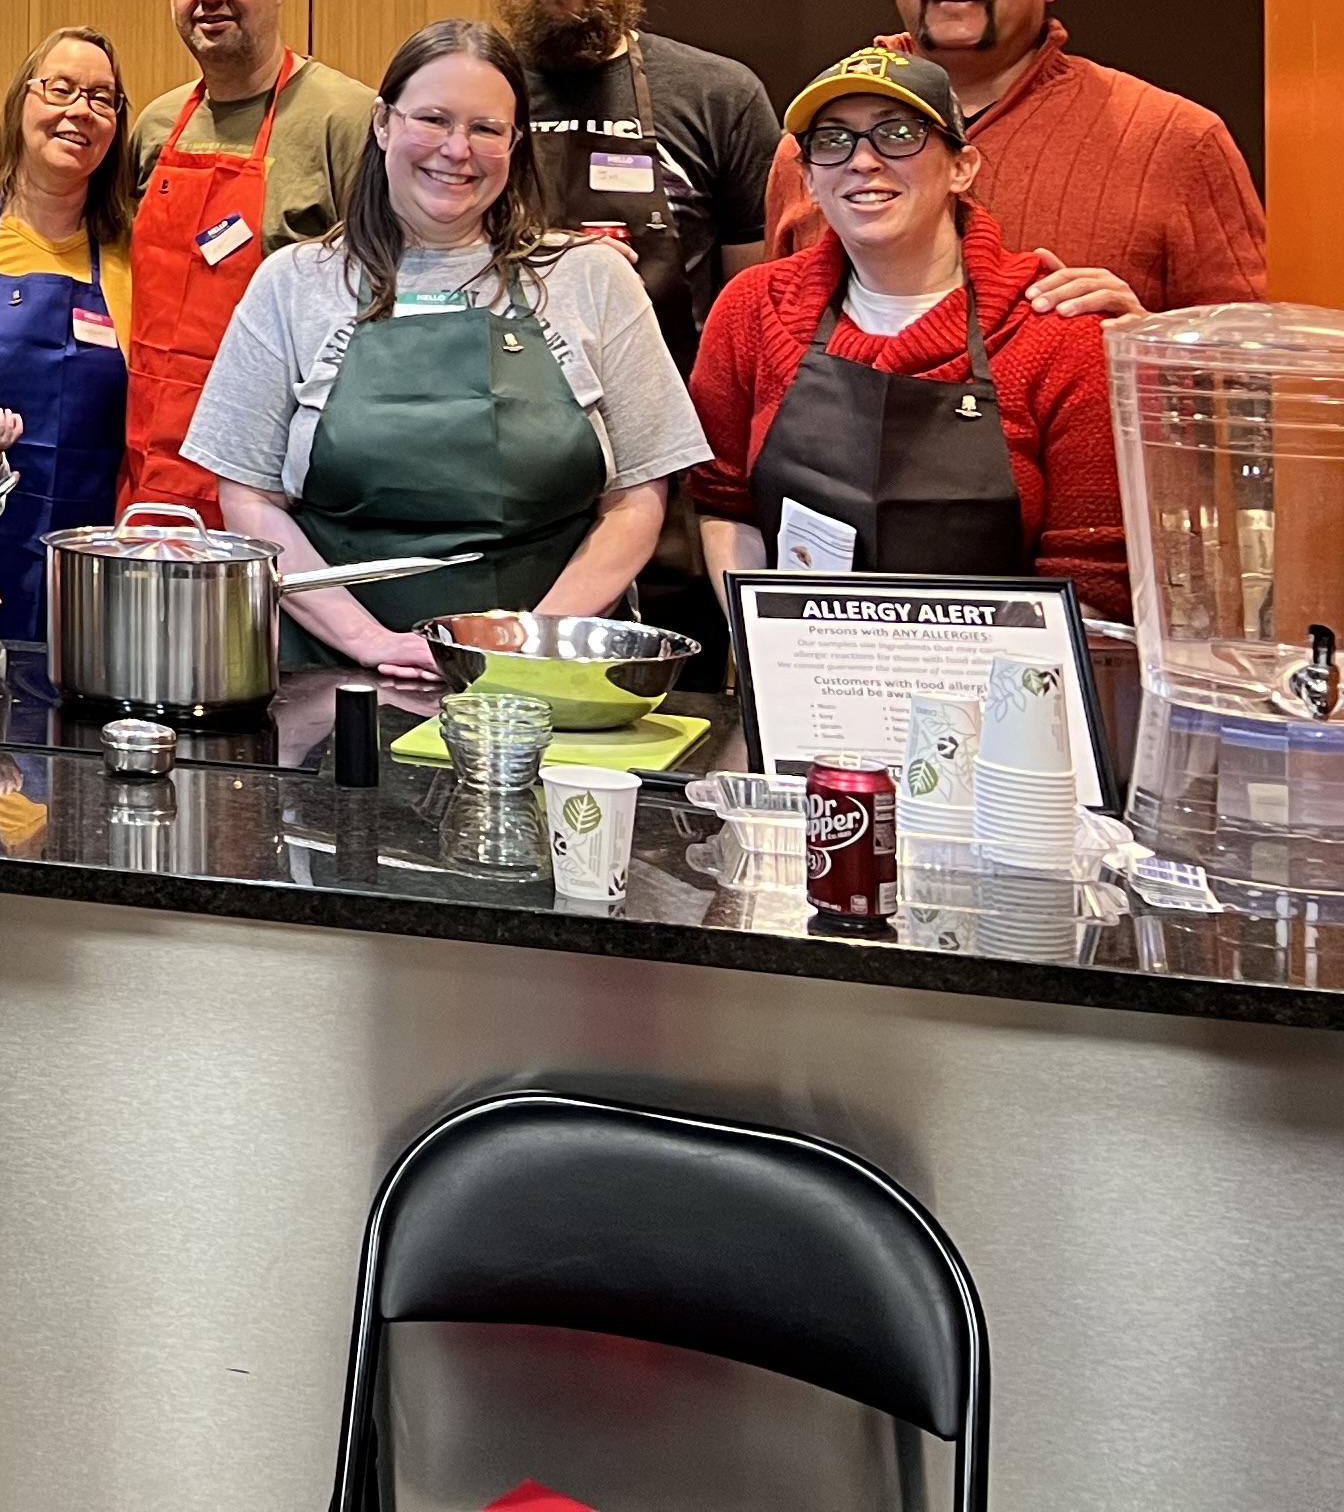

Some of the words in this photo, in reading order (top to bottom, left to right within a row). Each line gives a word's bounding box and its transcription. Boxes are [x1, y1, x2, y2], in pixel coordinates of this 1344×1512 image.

[416, 294, 447, 302] HELLO
[802, 600, 912, 622] ALLERGY
[918, 604, 997, 625] ALERT
[808, 625, 858, 637] Persons
[862, 627, 889, 637] with
[892, 629, 918, 640] ANY
[813, 675, 882, 688] Customers
[884, 677, 913, 689] with
[915, 679, 945, 691] food
[948, 681, 989, 694] allergi
[821, 686, 864, 696] should
[867, 687, 884, 697] be
[886, 689, 912, 699] awa
[810, 793, 838, 819] Dr
[807, 810, 862, 843] pper
